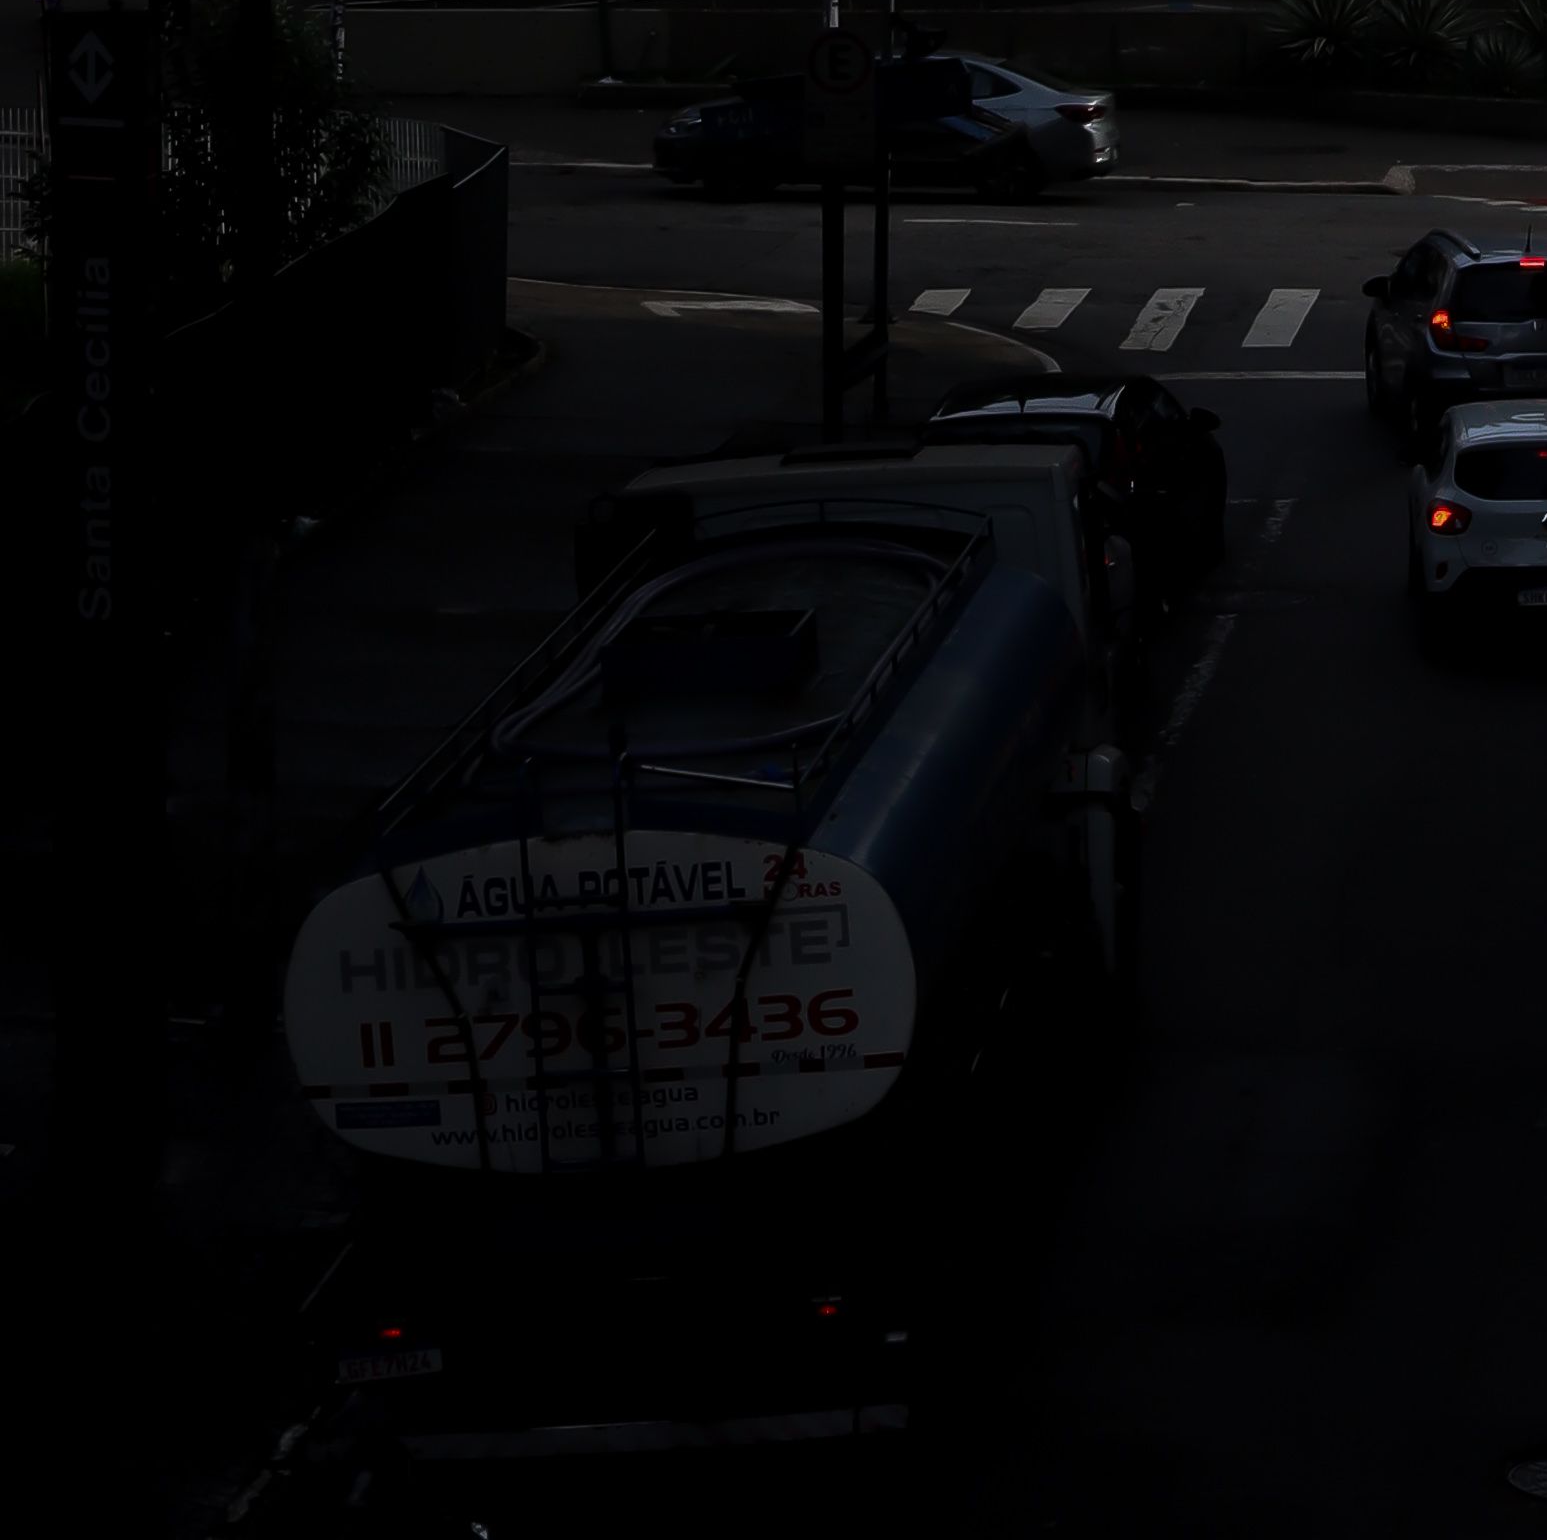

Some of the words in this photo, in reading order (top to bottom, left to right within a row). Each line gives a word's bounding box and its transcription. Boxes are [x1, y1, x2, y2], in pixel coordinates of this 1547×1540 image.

[829, 45, 851, 80] E
[75, 255, 112, 443] Cecília
[78, 463, 112, 620] Santa
[457, 868, 560, 918] ÁGUA
[578, 860, 746, 912] POTÁVEL
[763, 852, 808, 883] 24
[339, 933, 566, 993] HIDRO
[425, 989, 861, 1064] 2796-3436
[771, 1047, 816, 1064] Desde
[818, 1043, 858, 1061] 1996
[431, 1106, 781, 1147] www.hidroleseagua.com.br
